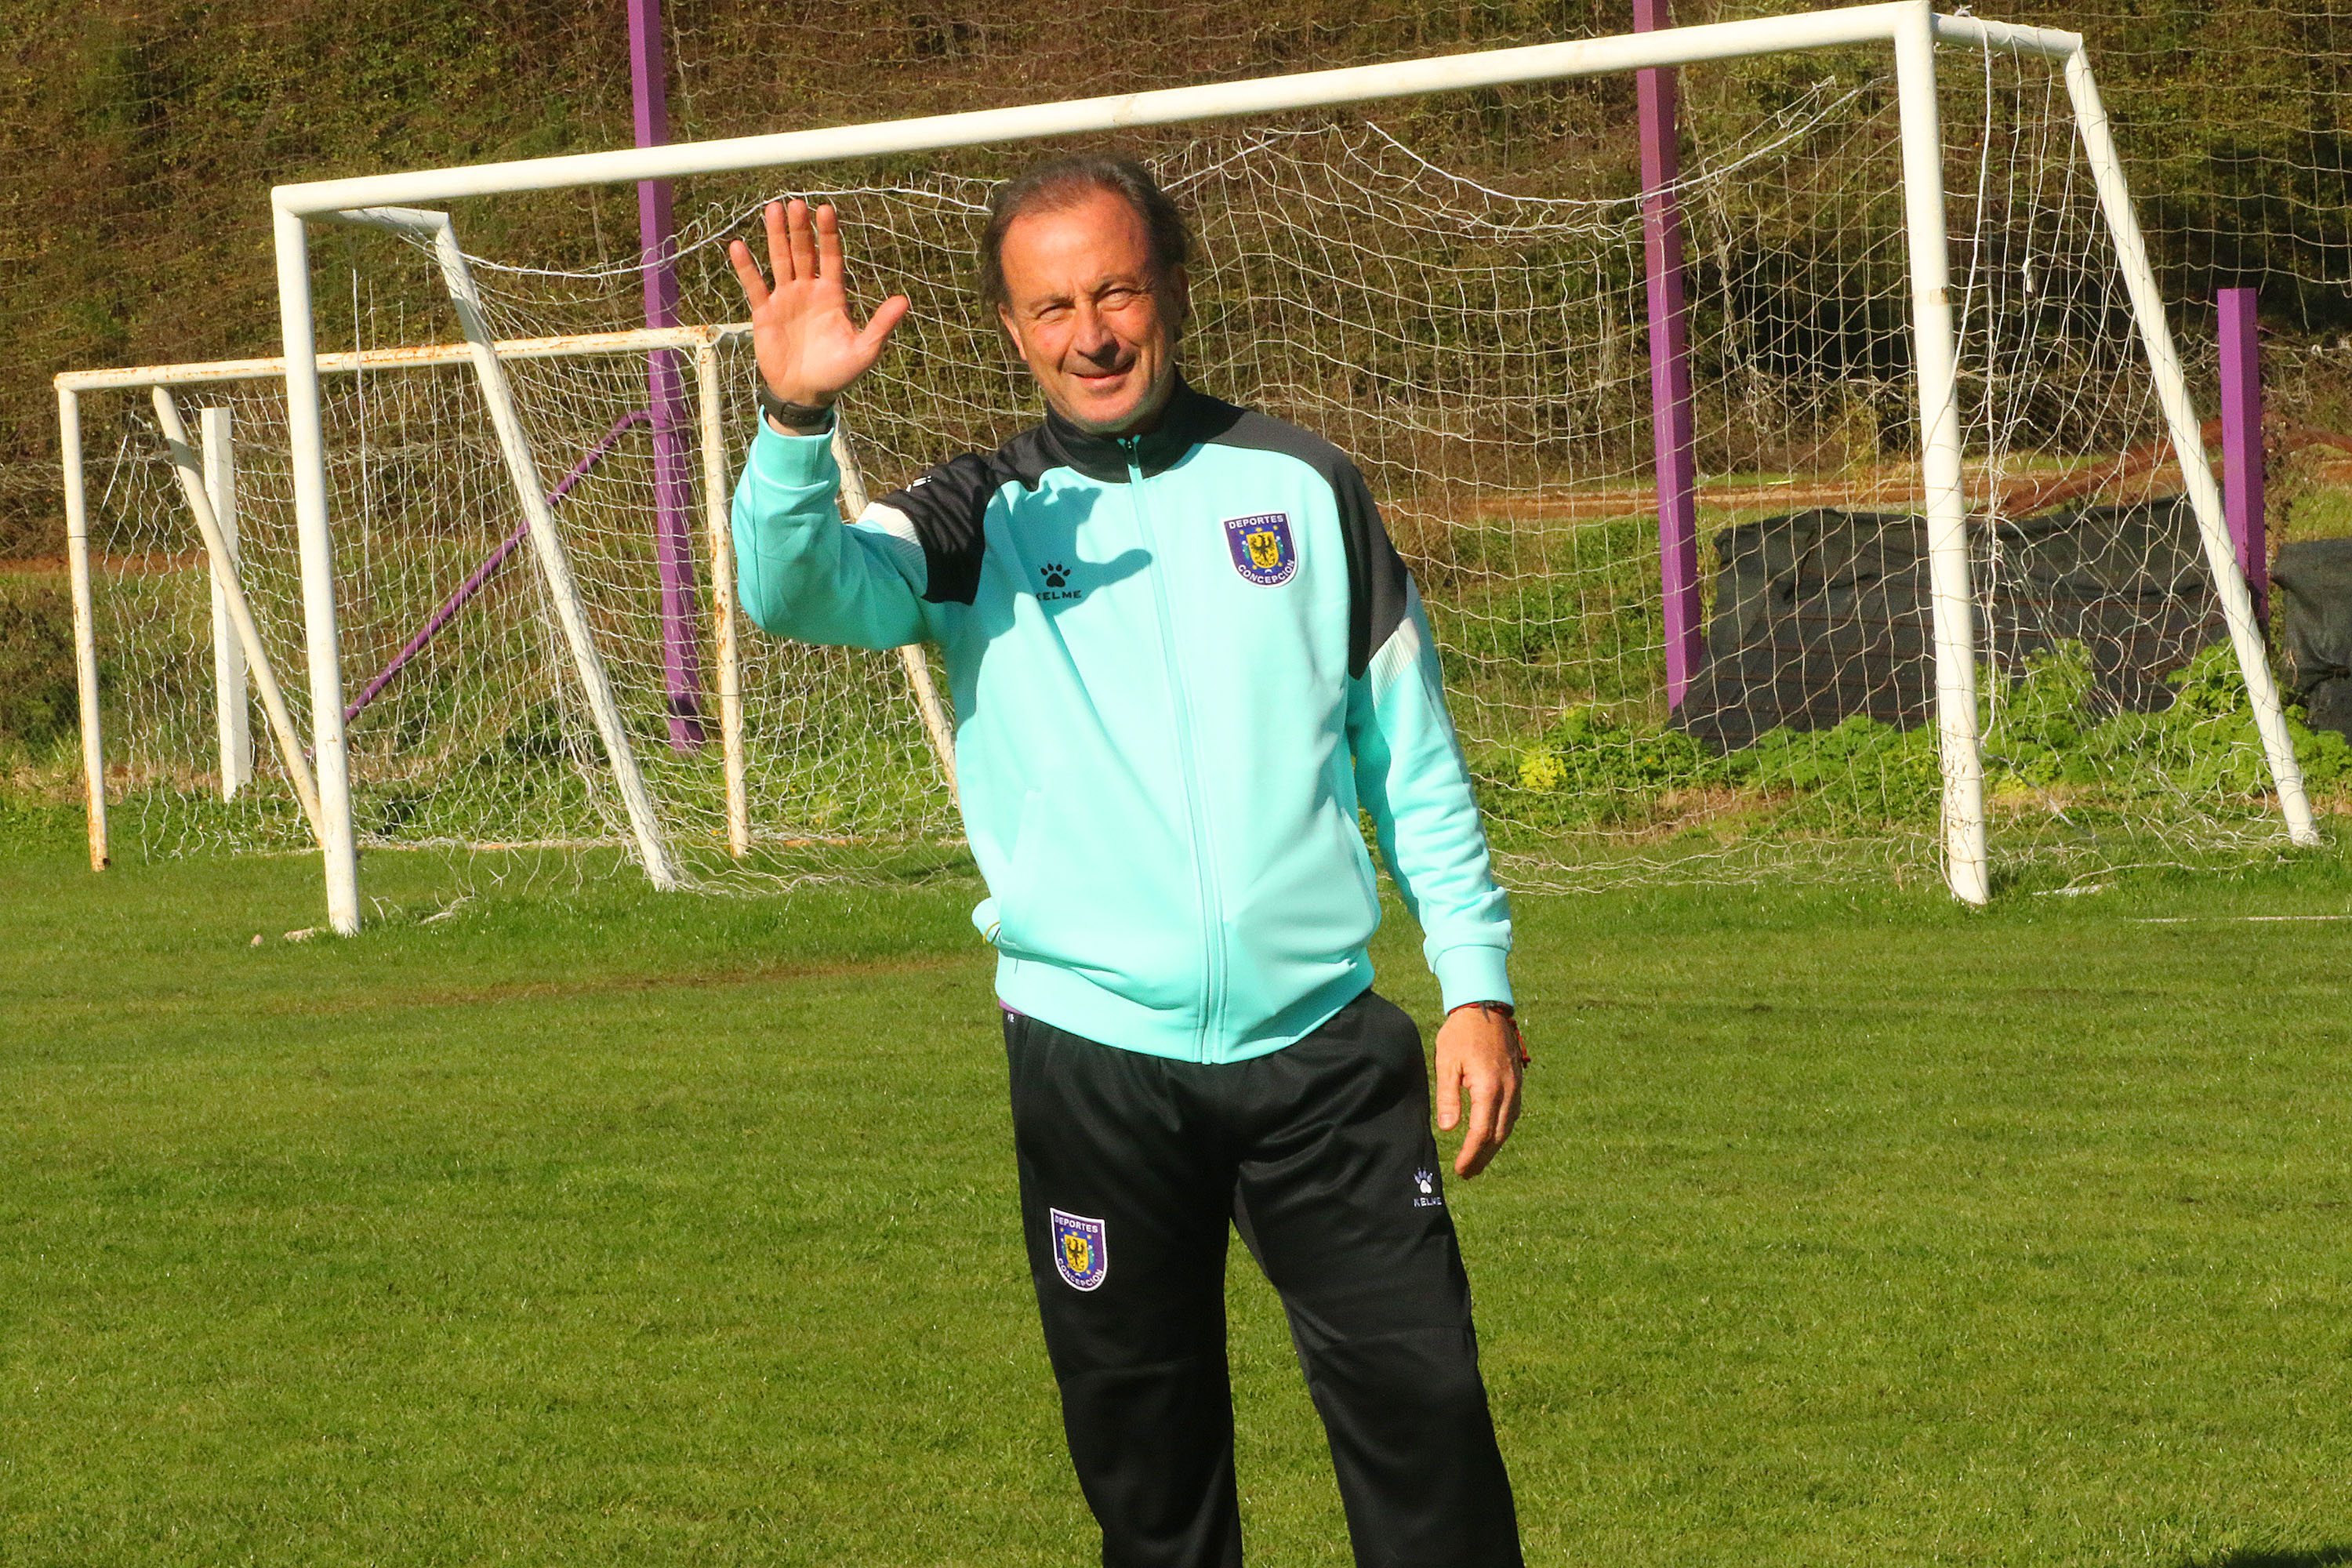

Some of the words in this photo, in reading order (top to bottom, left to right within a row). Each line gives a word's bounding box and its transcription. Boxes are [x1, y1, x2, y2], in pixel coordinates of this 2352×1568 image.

[1229, 515, 1284, 529] DEPORTES
[1238, 559, 1294, 584] CONCEPCION
[1054, 1215, 1098, 1233] DEPORTES
[1058, 1258, 1104, 1287] CONCEPCION
